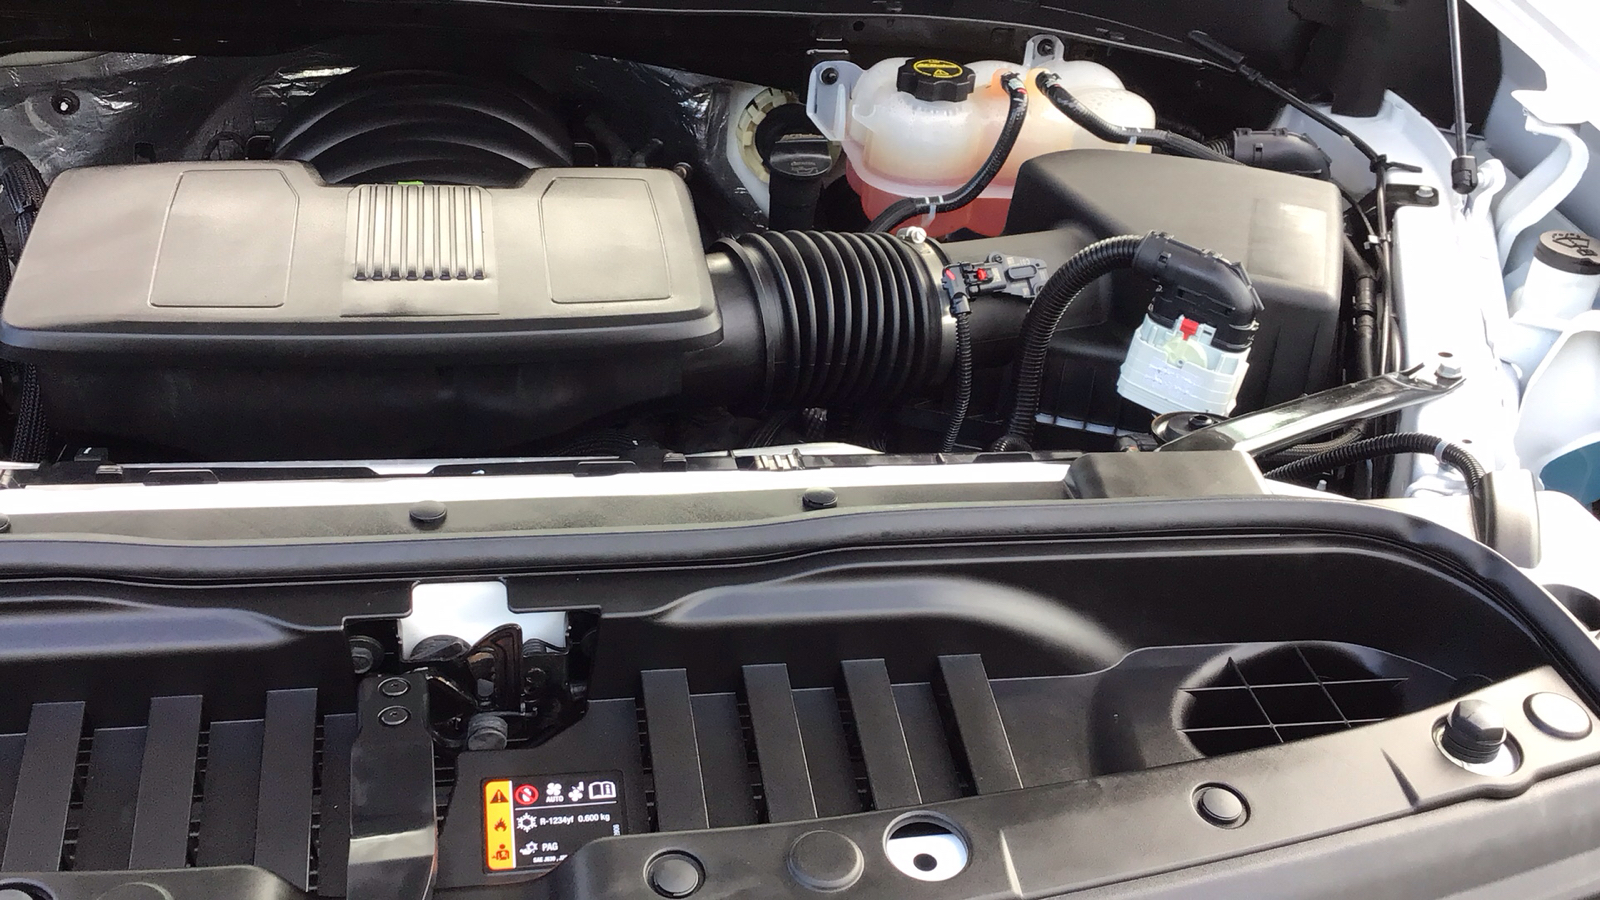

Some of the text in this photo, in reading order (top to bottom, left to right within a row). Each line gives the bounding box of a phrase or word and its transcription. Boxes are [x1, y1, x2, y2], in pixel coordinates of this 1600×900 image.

[540, 813, 610, 825] R-1234yf 0.600 kg
[542, 842, 558, 851] PAG
